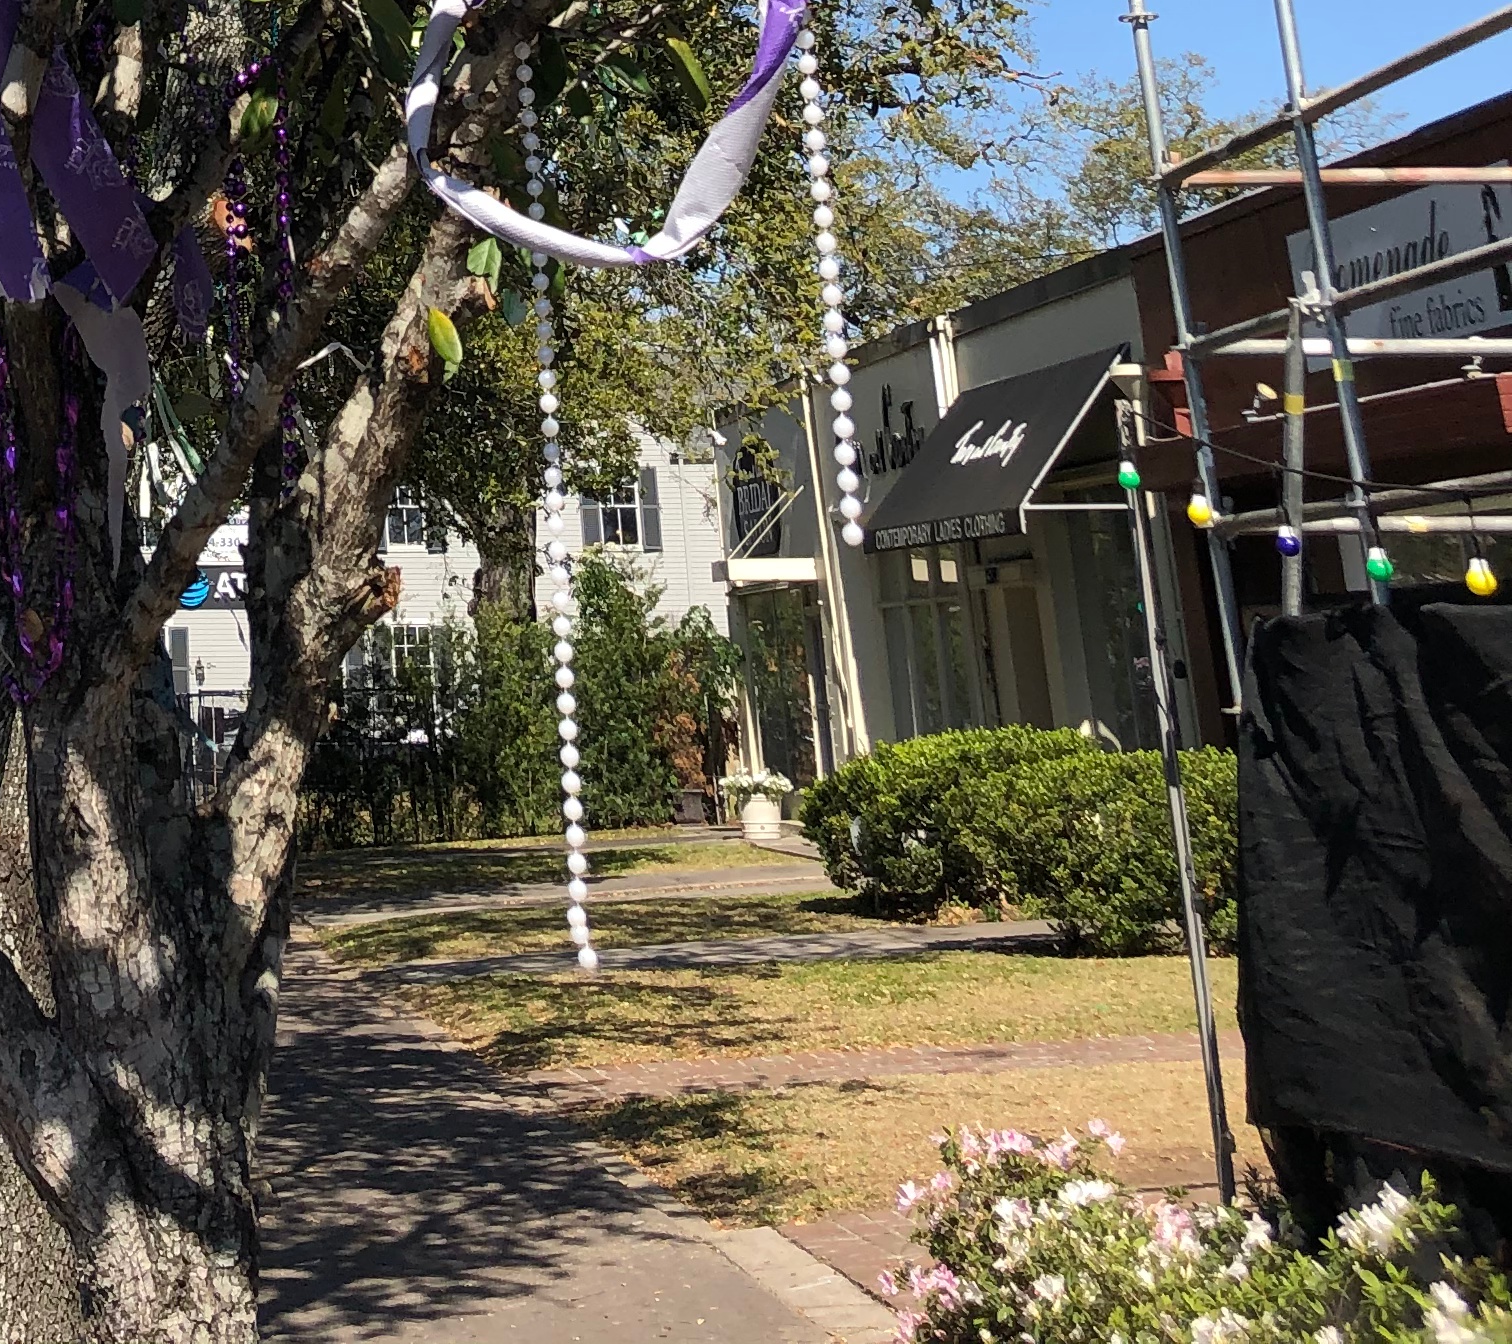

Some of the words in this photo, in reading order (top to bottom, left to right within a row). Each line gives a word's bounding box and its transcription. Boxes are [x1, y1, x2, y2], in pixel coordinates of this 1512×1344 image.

[1313, 199, 1450, 290] omenade
[1389, 305, 1424, 339] fine
[1425, 289, 1486, 336] fabrics
[736, 480, 773, 516] BRIDAL
[875, 522, 932, 550] CONTEMPORARY
[933, 518, 962, 542] LADIES
[963, 512, 1006, 539] CLOTHING
